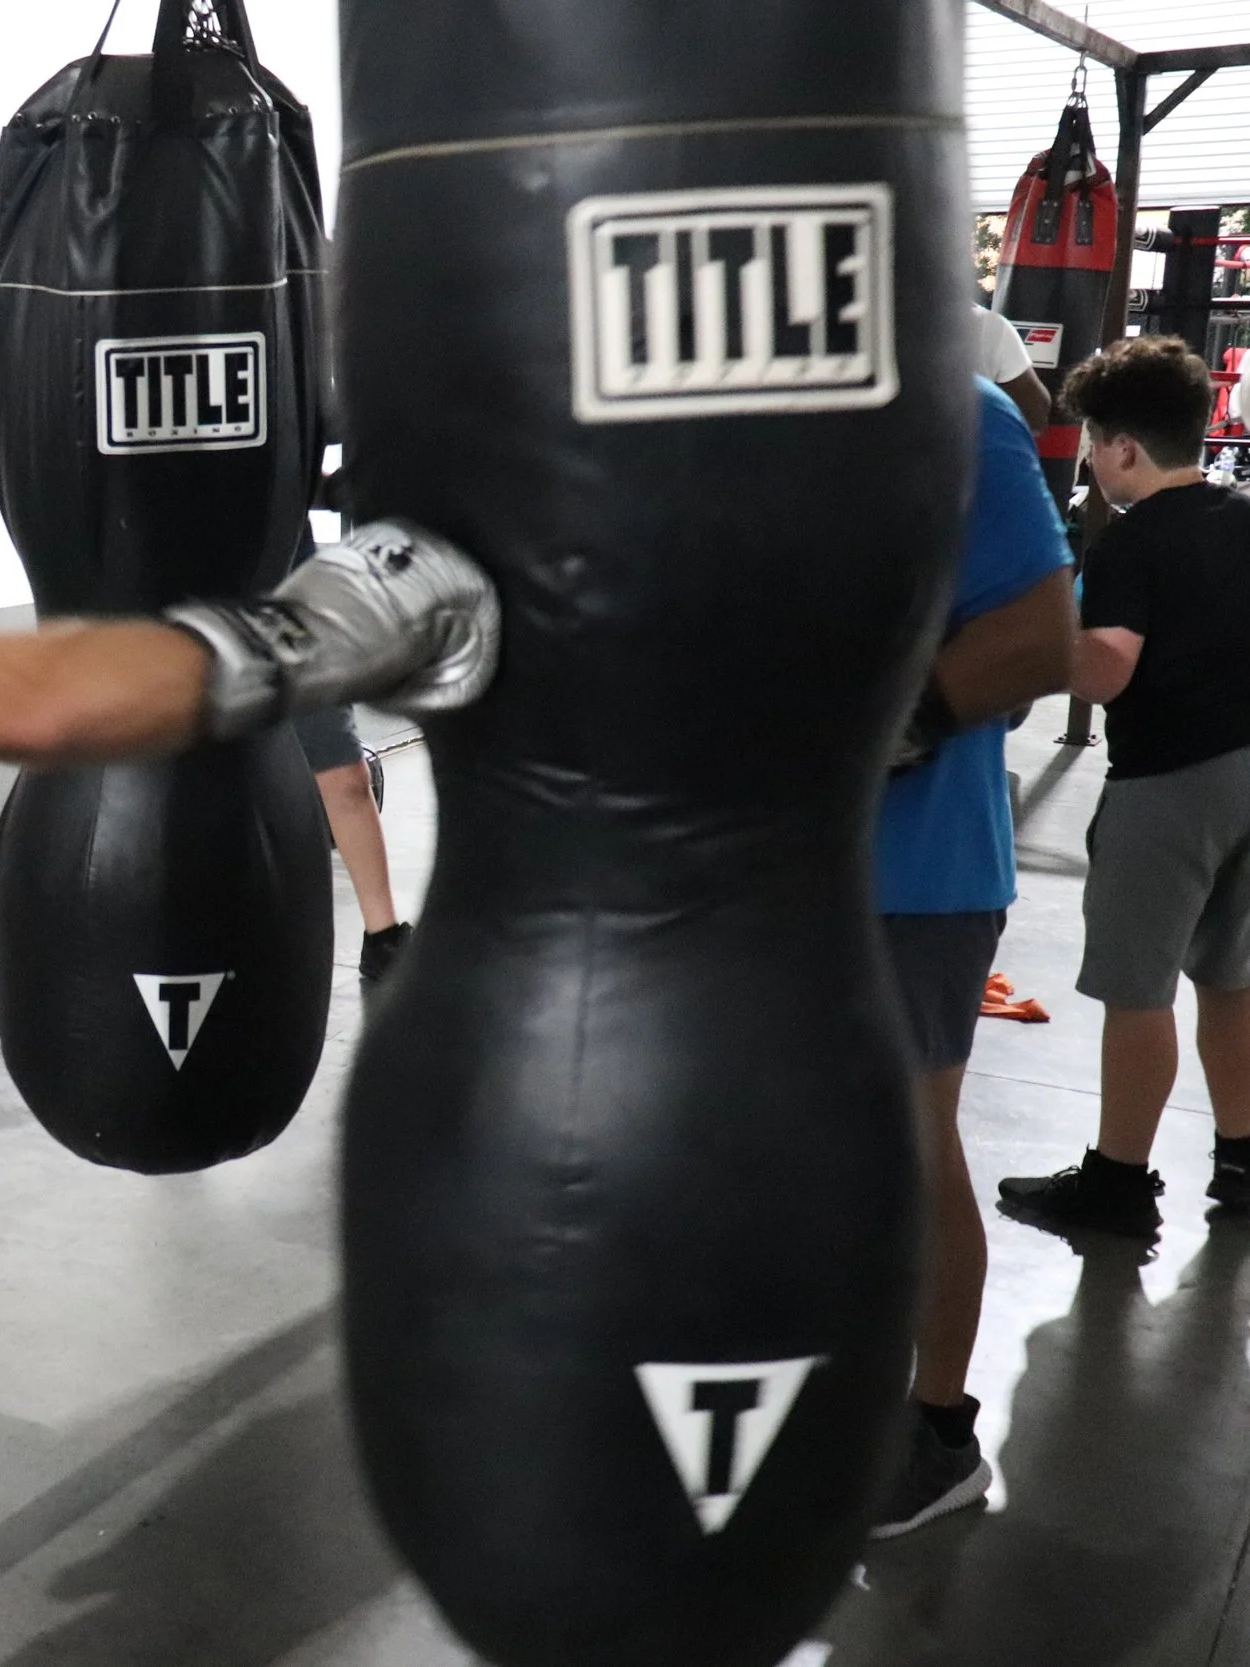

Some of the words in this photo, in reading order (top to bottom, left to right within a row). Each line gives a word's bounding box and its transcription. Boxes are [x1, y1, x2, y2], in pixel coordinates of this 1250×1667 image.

[613, 222, 859, 365] TITLE
[115, 352, 250, 429] TITLE
[159, 982, 201, 1050] T
[689, 1377, 763, 1497] T
